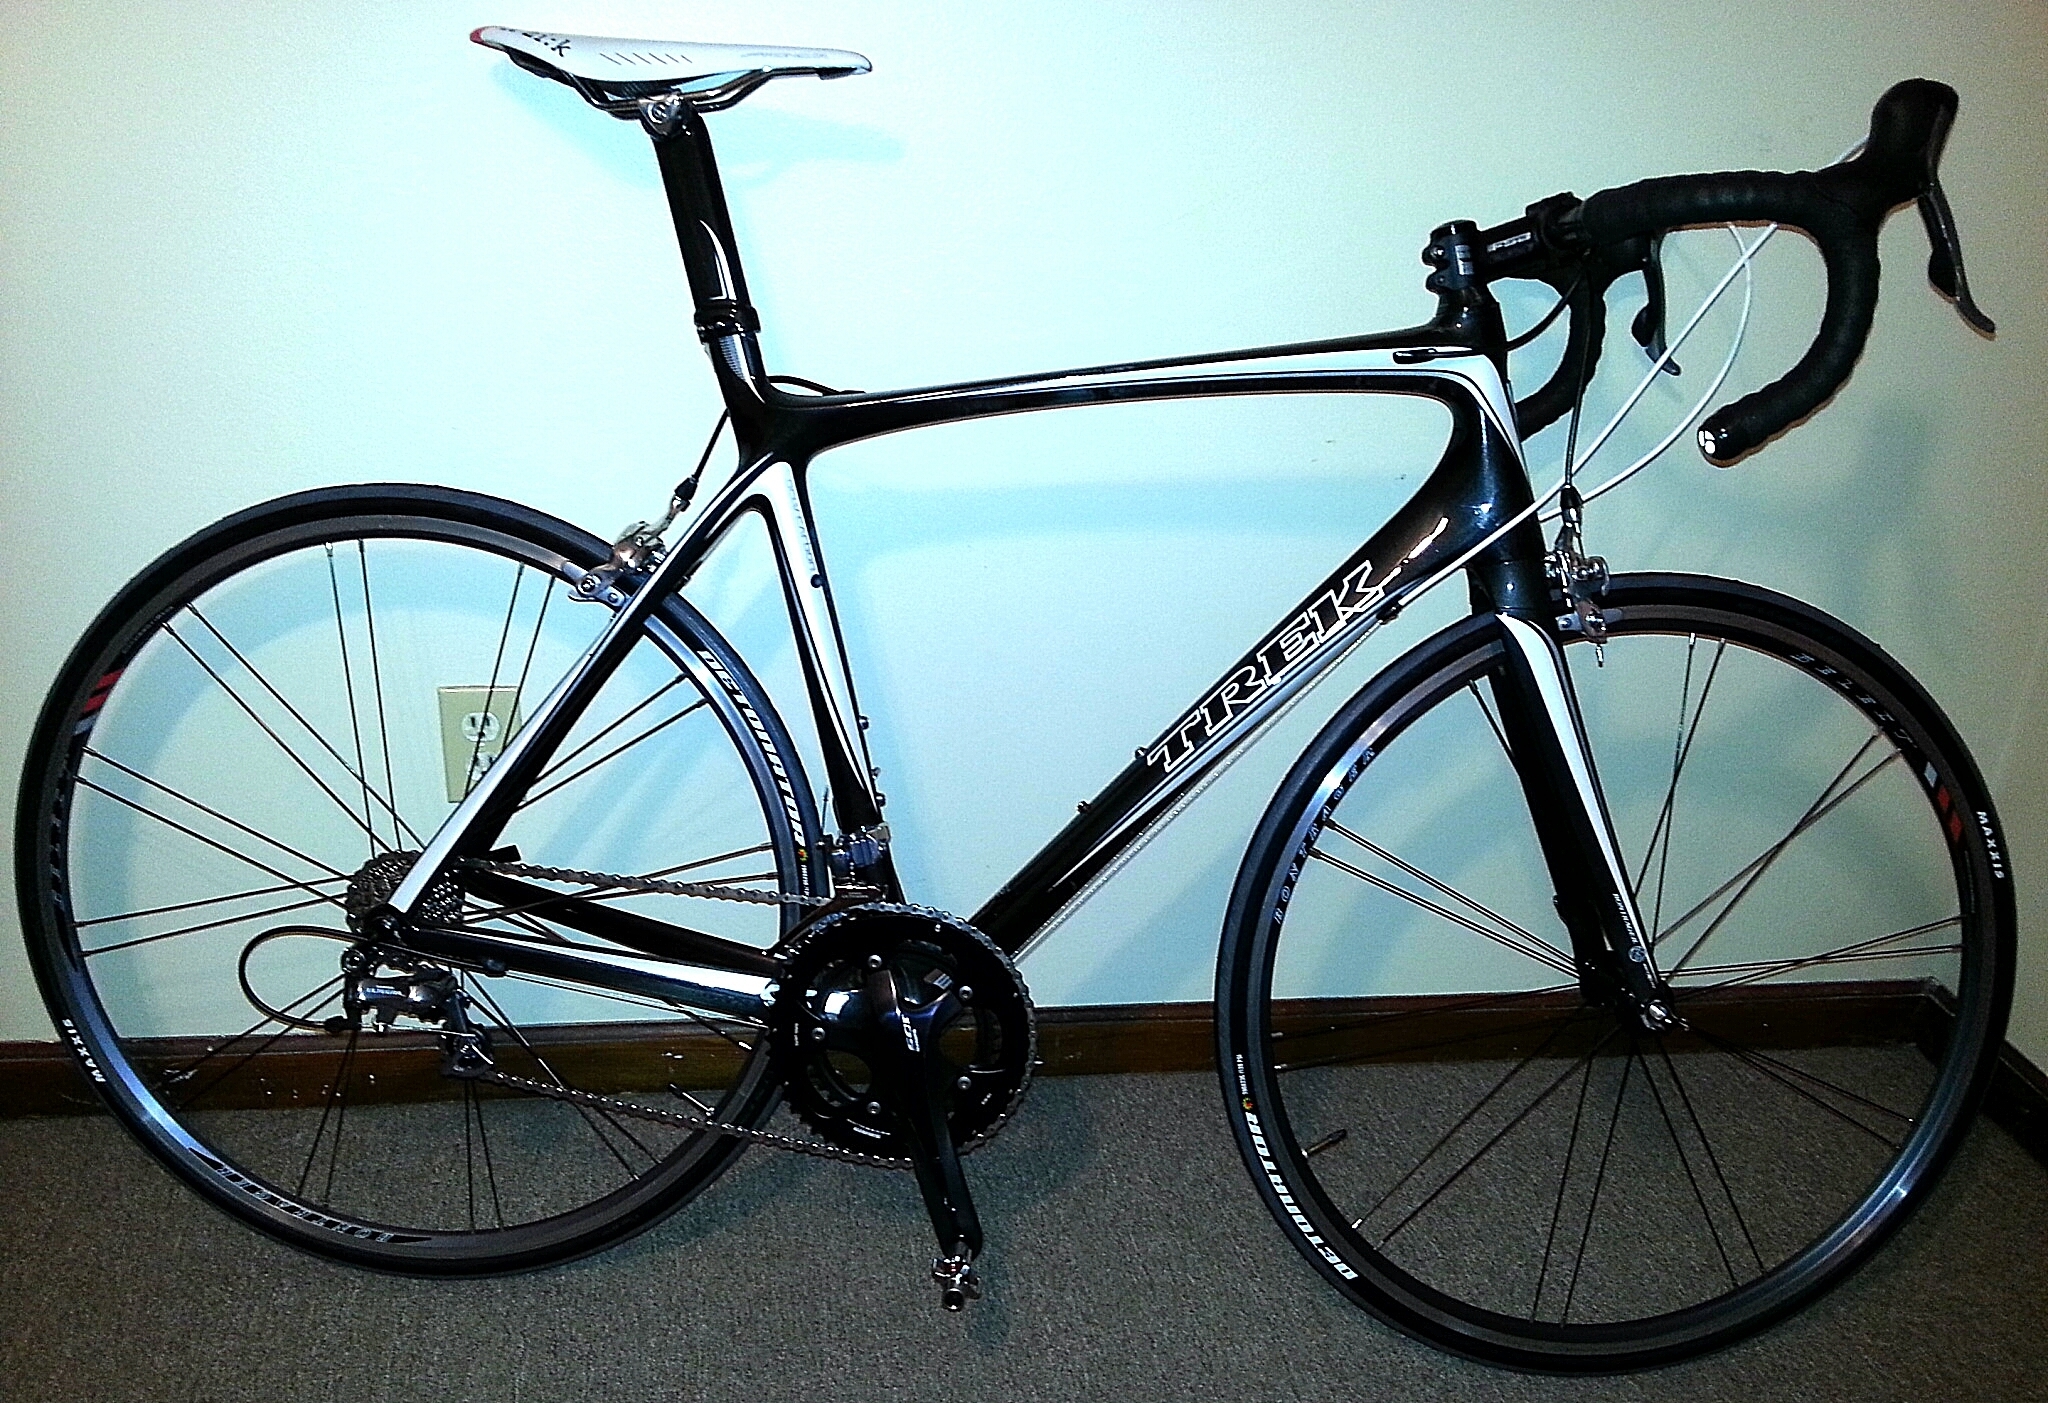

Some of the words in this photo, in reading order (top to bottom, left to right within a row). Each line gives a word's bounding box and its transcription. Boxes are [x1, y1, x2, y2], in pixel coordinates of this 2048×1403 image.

[697, 650, 806, 847] DETONATOR
[1147, 559, 1385, 773] TREK
[1976, 811, 2005, 878] MAXXIS
[62, 1019, 107, 1082] MAXXIS
[1245, 1112, 1359, 1279] DETONATOR
